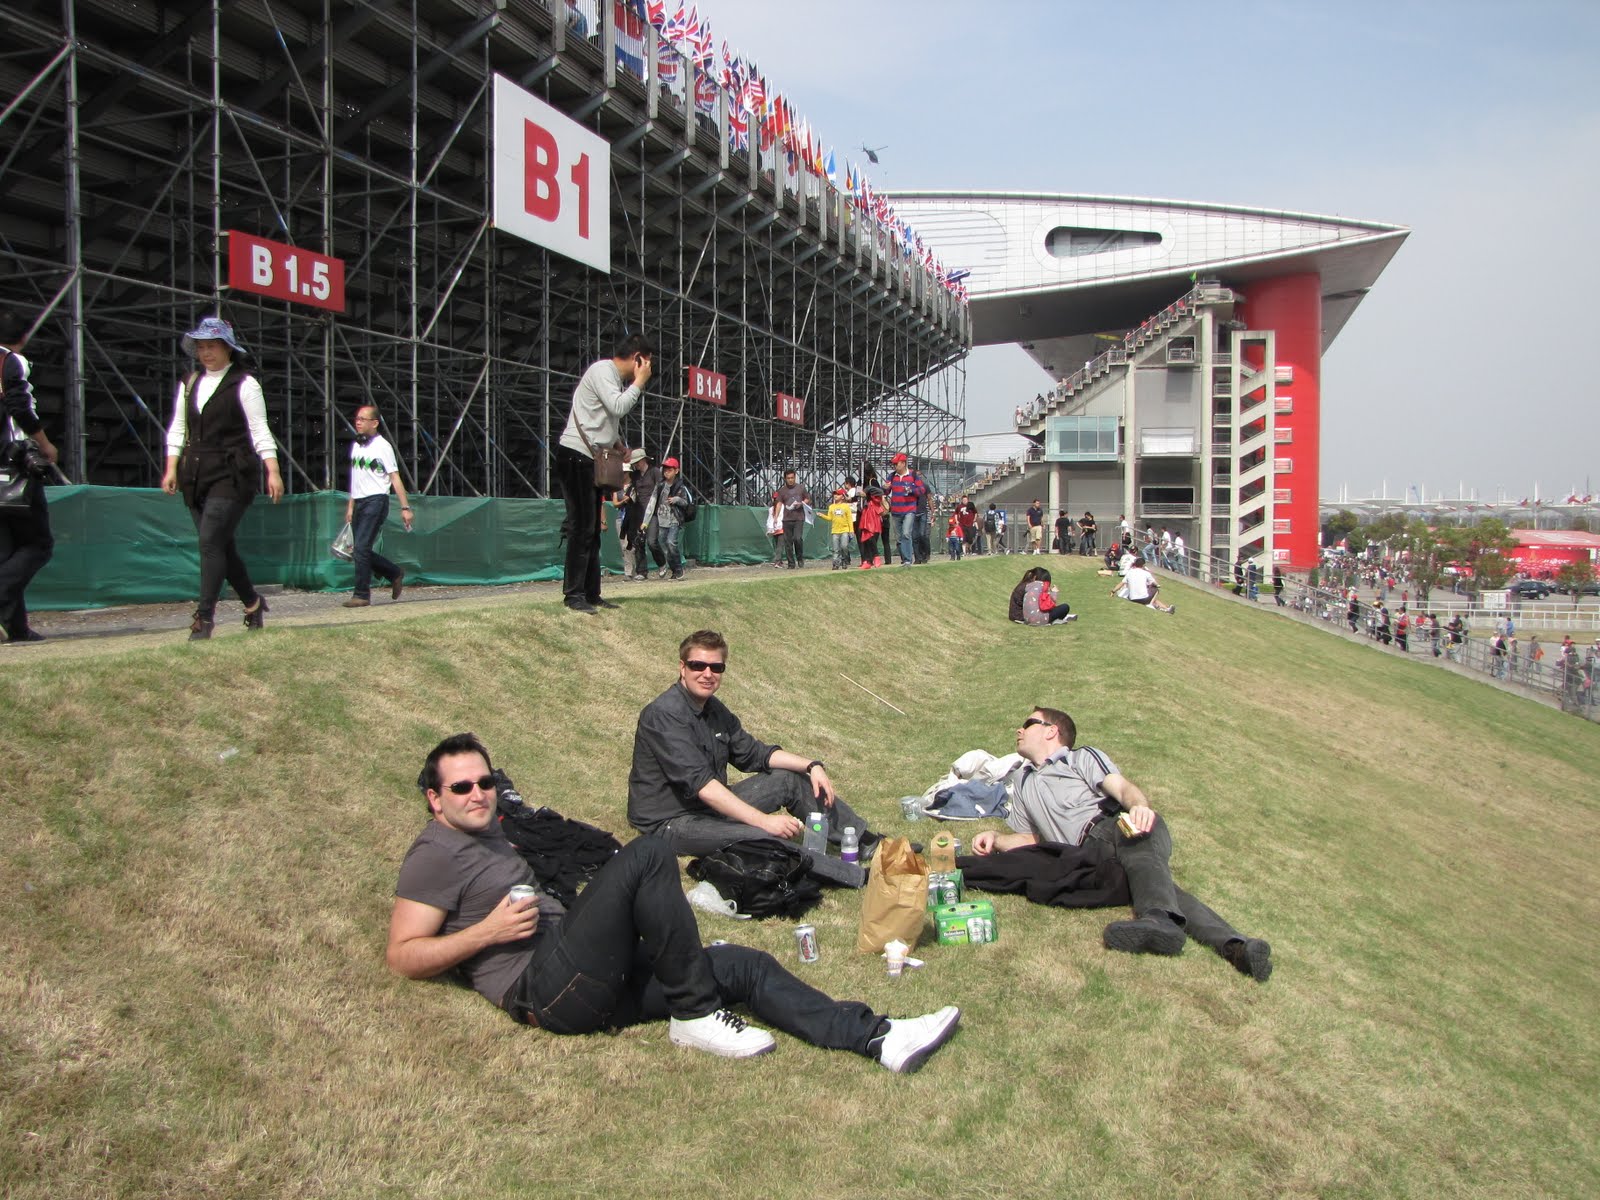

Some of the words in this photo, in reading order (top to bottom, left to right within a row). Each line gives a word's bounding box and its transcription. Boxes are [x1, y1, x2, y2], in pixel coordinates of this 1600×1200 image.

[524, 117, 590, 240] B1
[252, 244, 273, 287] B
[285, 254, 331, 300] 1.5
[696, 373, 704, 395] B
[706, 376, 721, 400] 1.4
